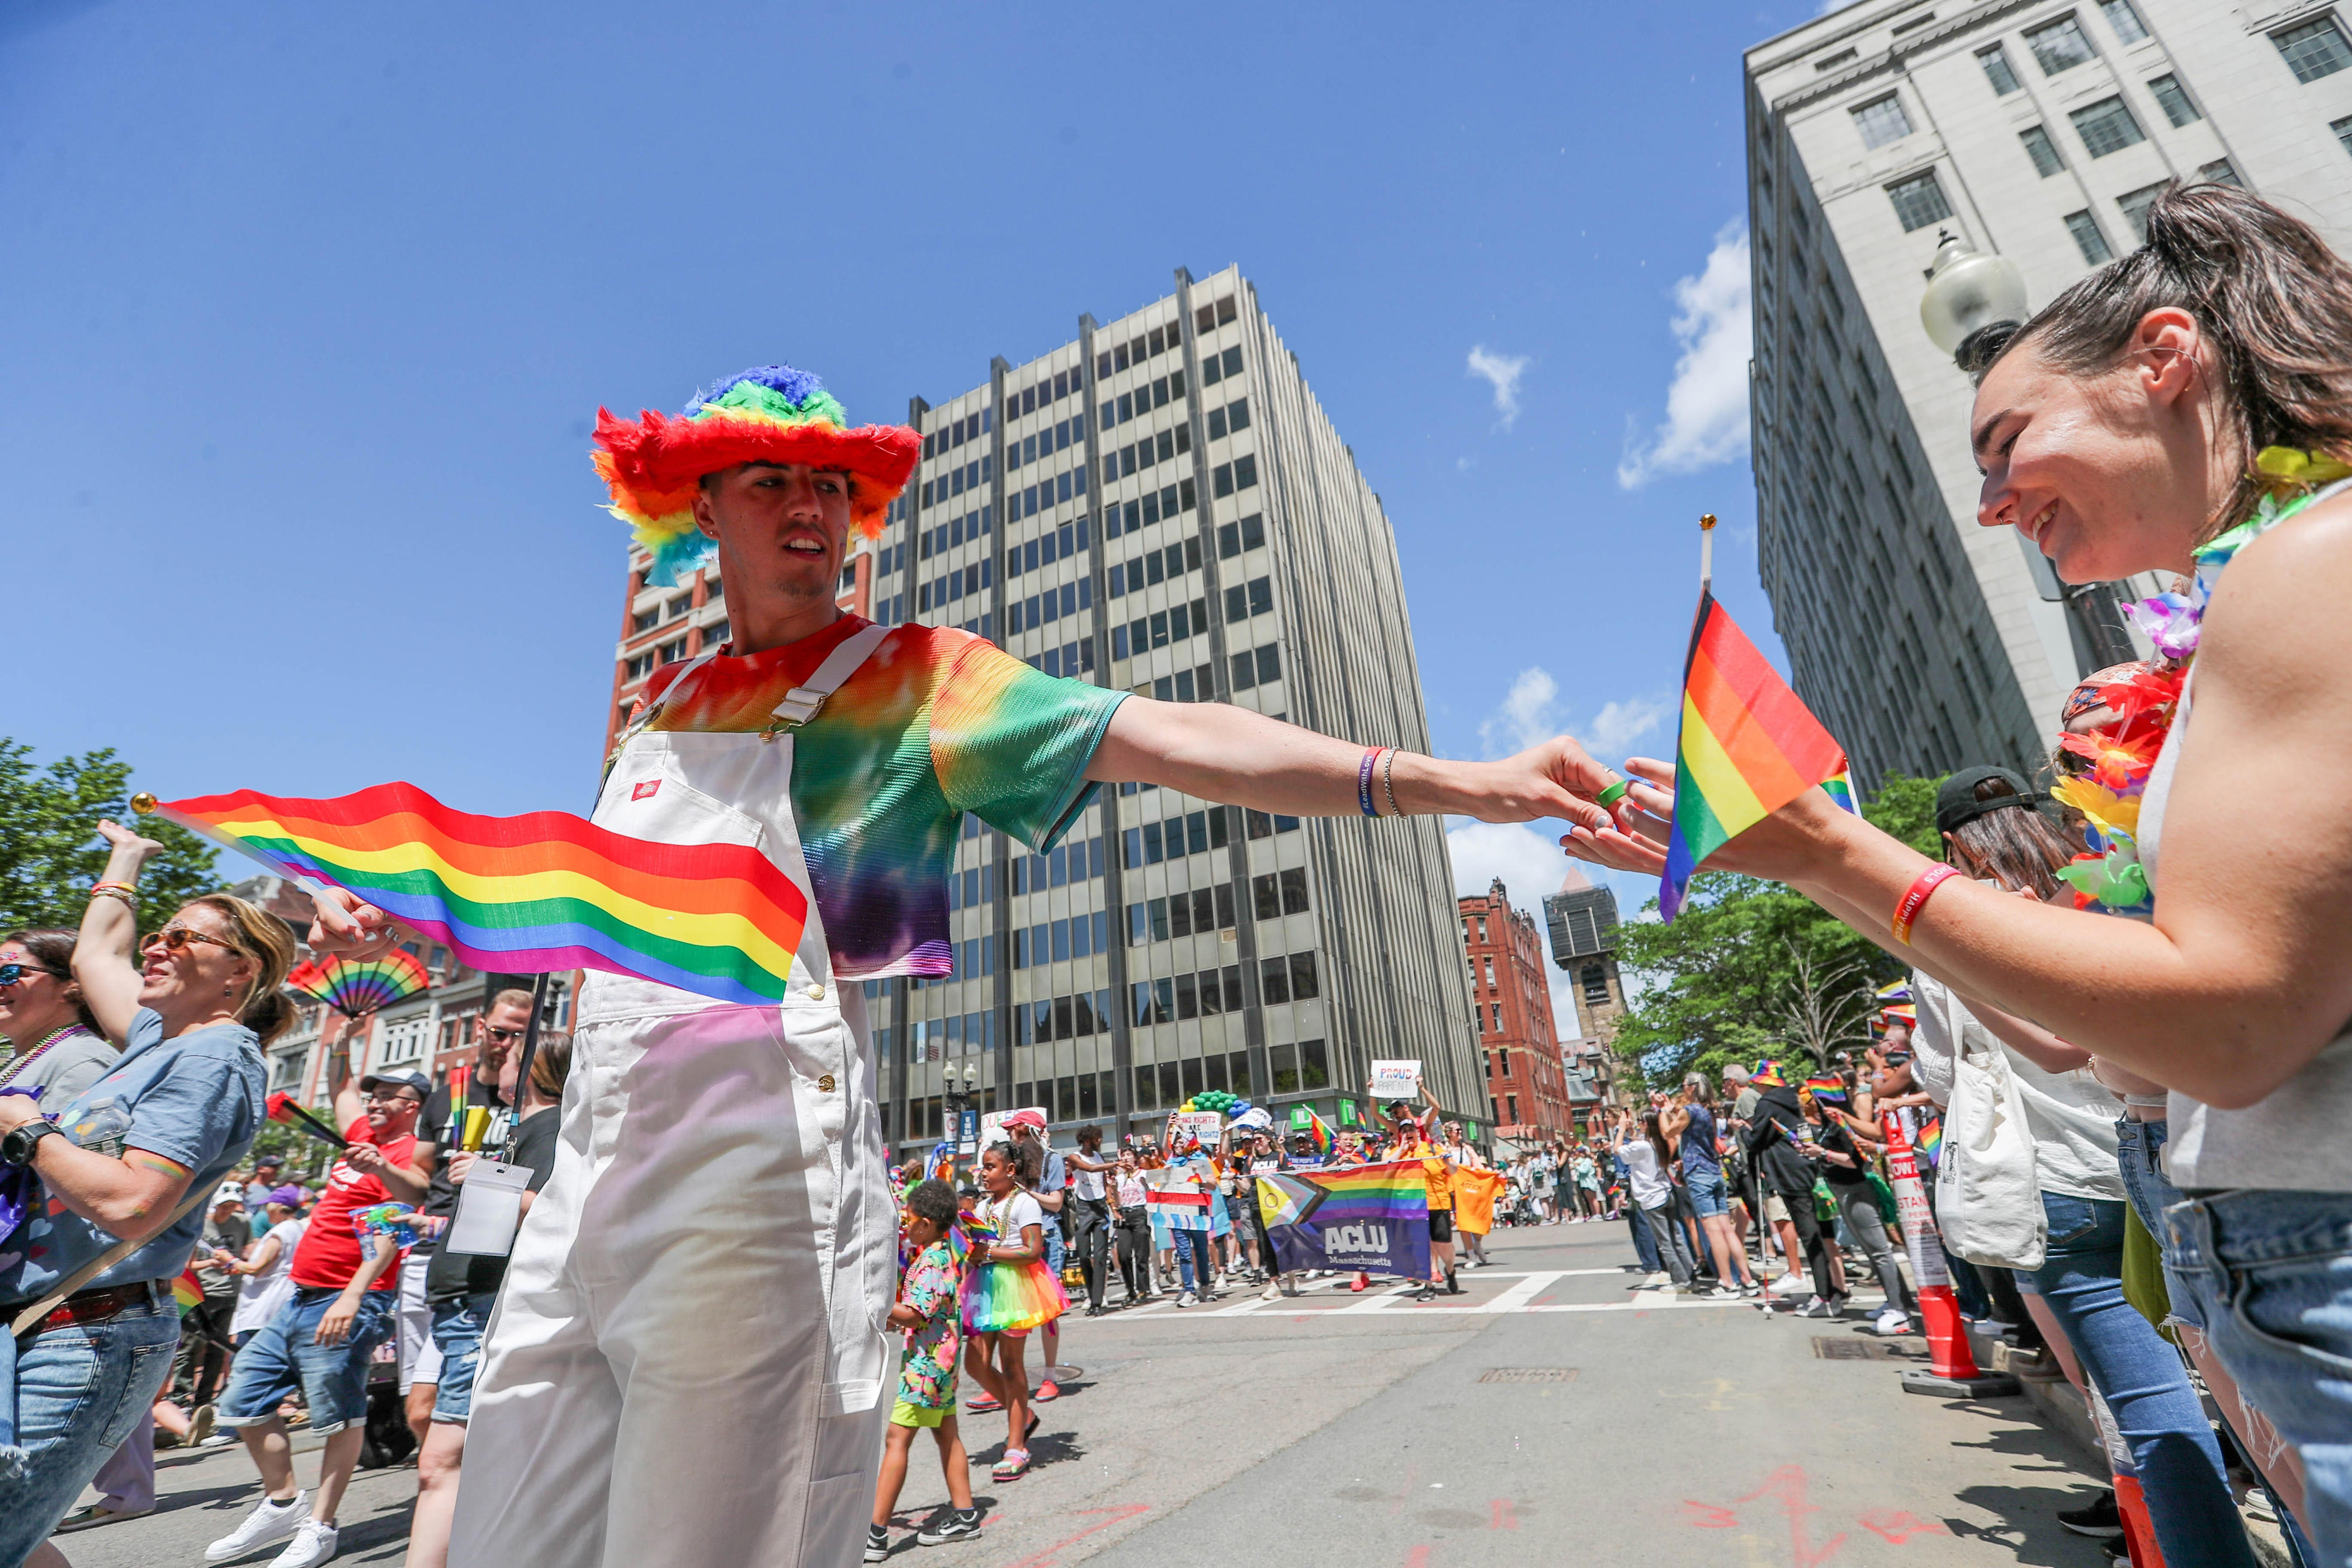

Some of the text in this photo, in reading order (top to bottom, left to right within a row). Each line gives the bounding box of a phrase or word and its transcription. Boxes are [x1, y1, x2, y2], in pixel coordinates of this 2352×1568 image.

[1361, 755, 1372, 809] #LeadWithLove
[1899, 892, 1920, 923] HAPPY
[1381, 1068, 1412, 1079] PROUD
[1378, 1080, 1410, 1092] PARENT
[1250, 1160, 1279, 1171] ACLU
[1325, 1225, 1389, 1254] ACLU
[1328, 1255, 1392, 1267] Massachusetts
